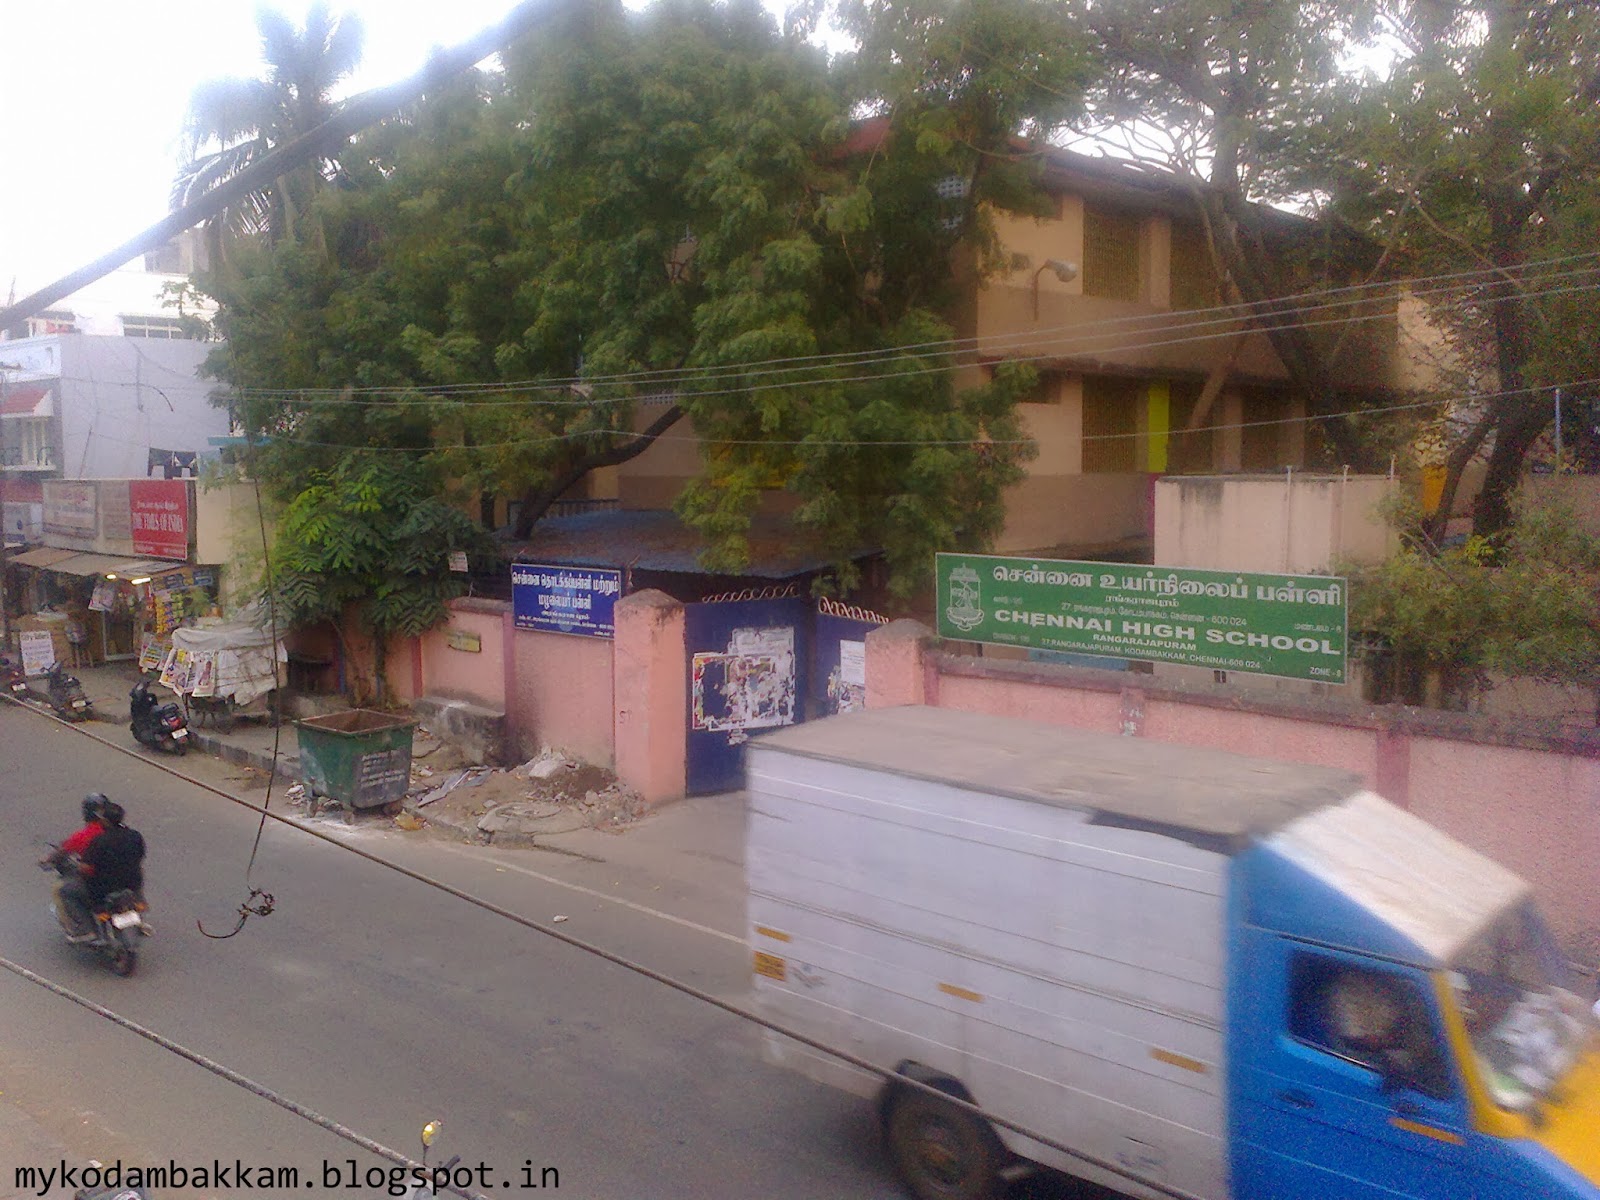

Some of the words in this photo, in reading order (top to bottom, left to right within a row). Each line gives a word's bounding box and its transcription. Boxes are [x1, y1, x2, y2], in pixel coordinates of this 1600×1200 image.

[512, 570, 540, 586] சென்னை
[593, 575, 619, 596] மற்றும்
[993, 564, 1094, 587] சென்னை
[1099, 572, 1248, 598] உயர்நிலைப்
[1256, 581, 1341, 605] பள்ளி
[538, 592, 571, 610] மழலையர்
[572, 594, 592, 610] பள்ளி
[1212, 615, 1228, 625] 600
[1230, 617, 1248, 626] 024
[994, 609, 1112, 632] CHENNAI
[1122, 620, 1195, 640] HIGH
[1205, 628, 1341, 655] SCHOOL
[1093, 633, 1197, 651] RANGARAJAPURAM
